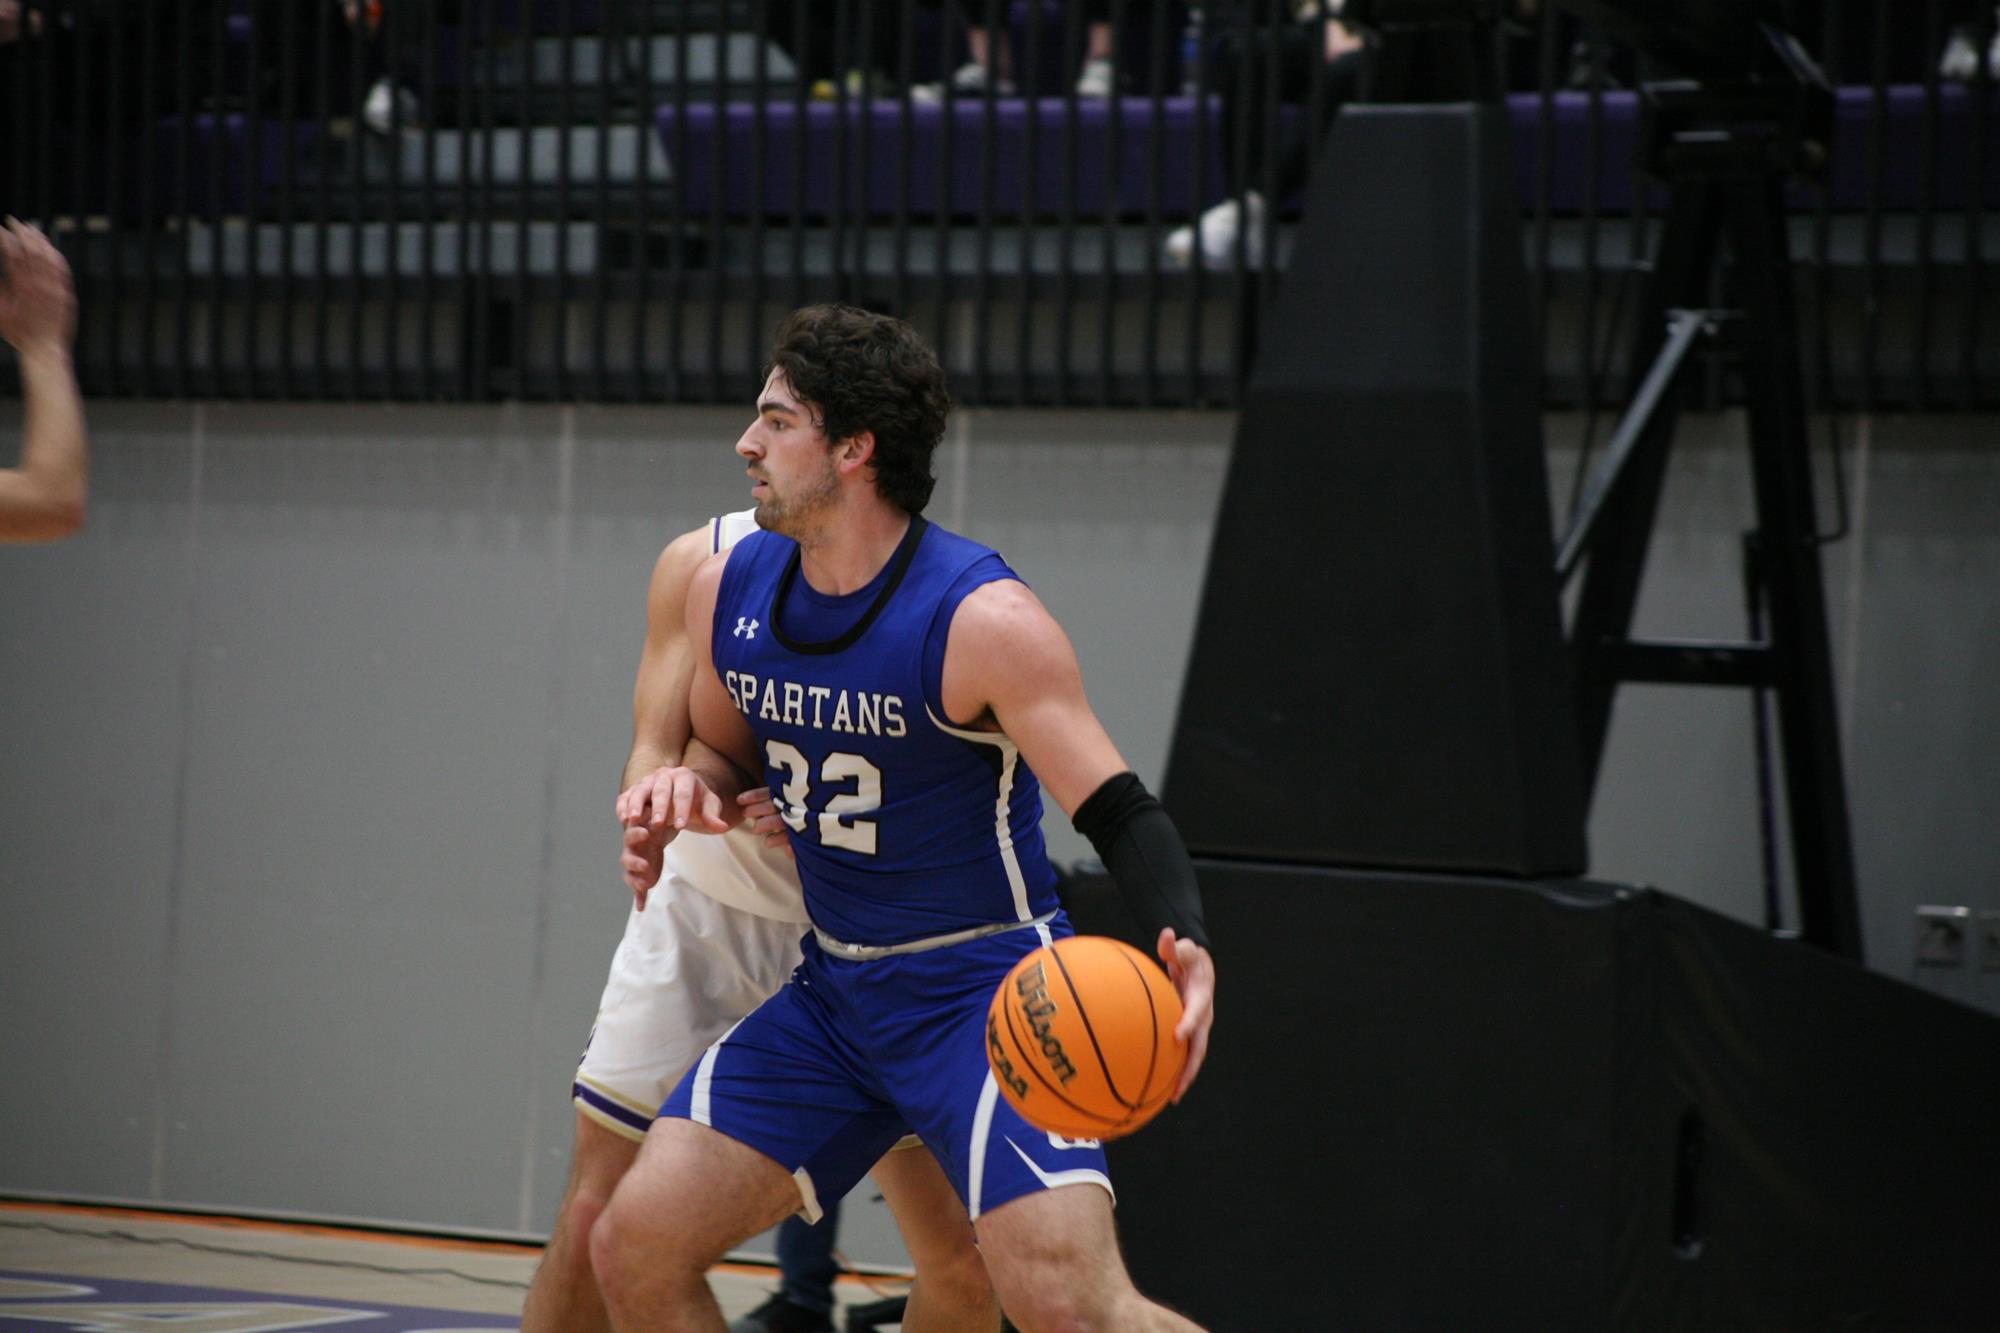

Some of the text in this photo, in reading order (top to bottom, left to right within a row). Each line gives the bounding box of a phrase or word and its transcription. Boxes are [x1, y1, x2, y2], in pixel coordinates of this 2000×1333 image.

[726, 670, 907, 737] SPARTANS
[765, 739, 882, 855] 32
[1017, 958, 1077, 1085] Wilson
